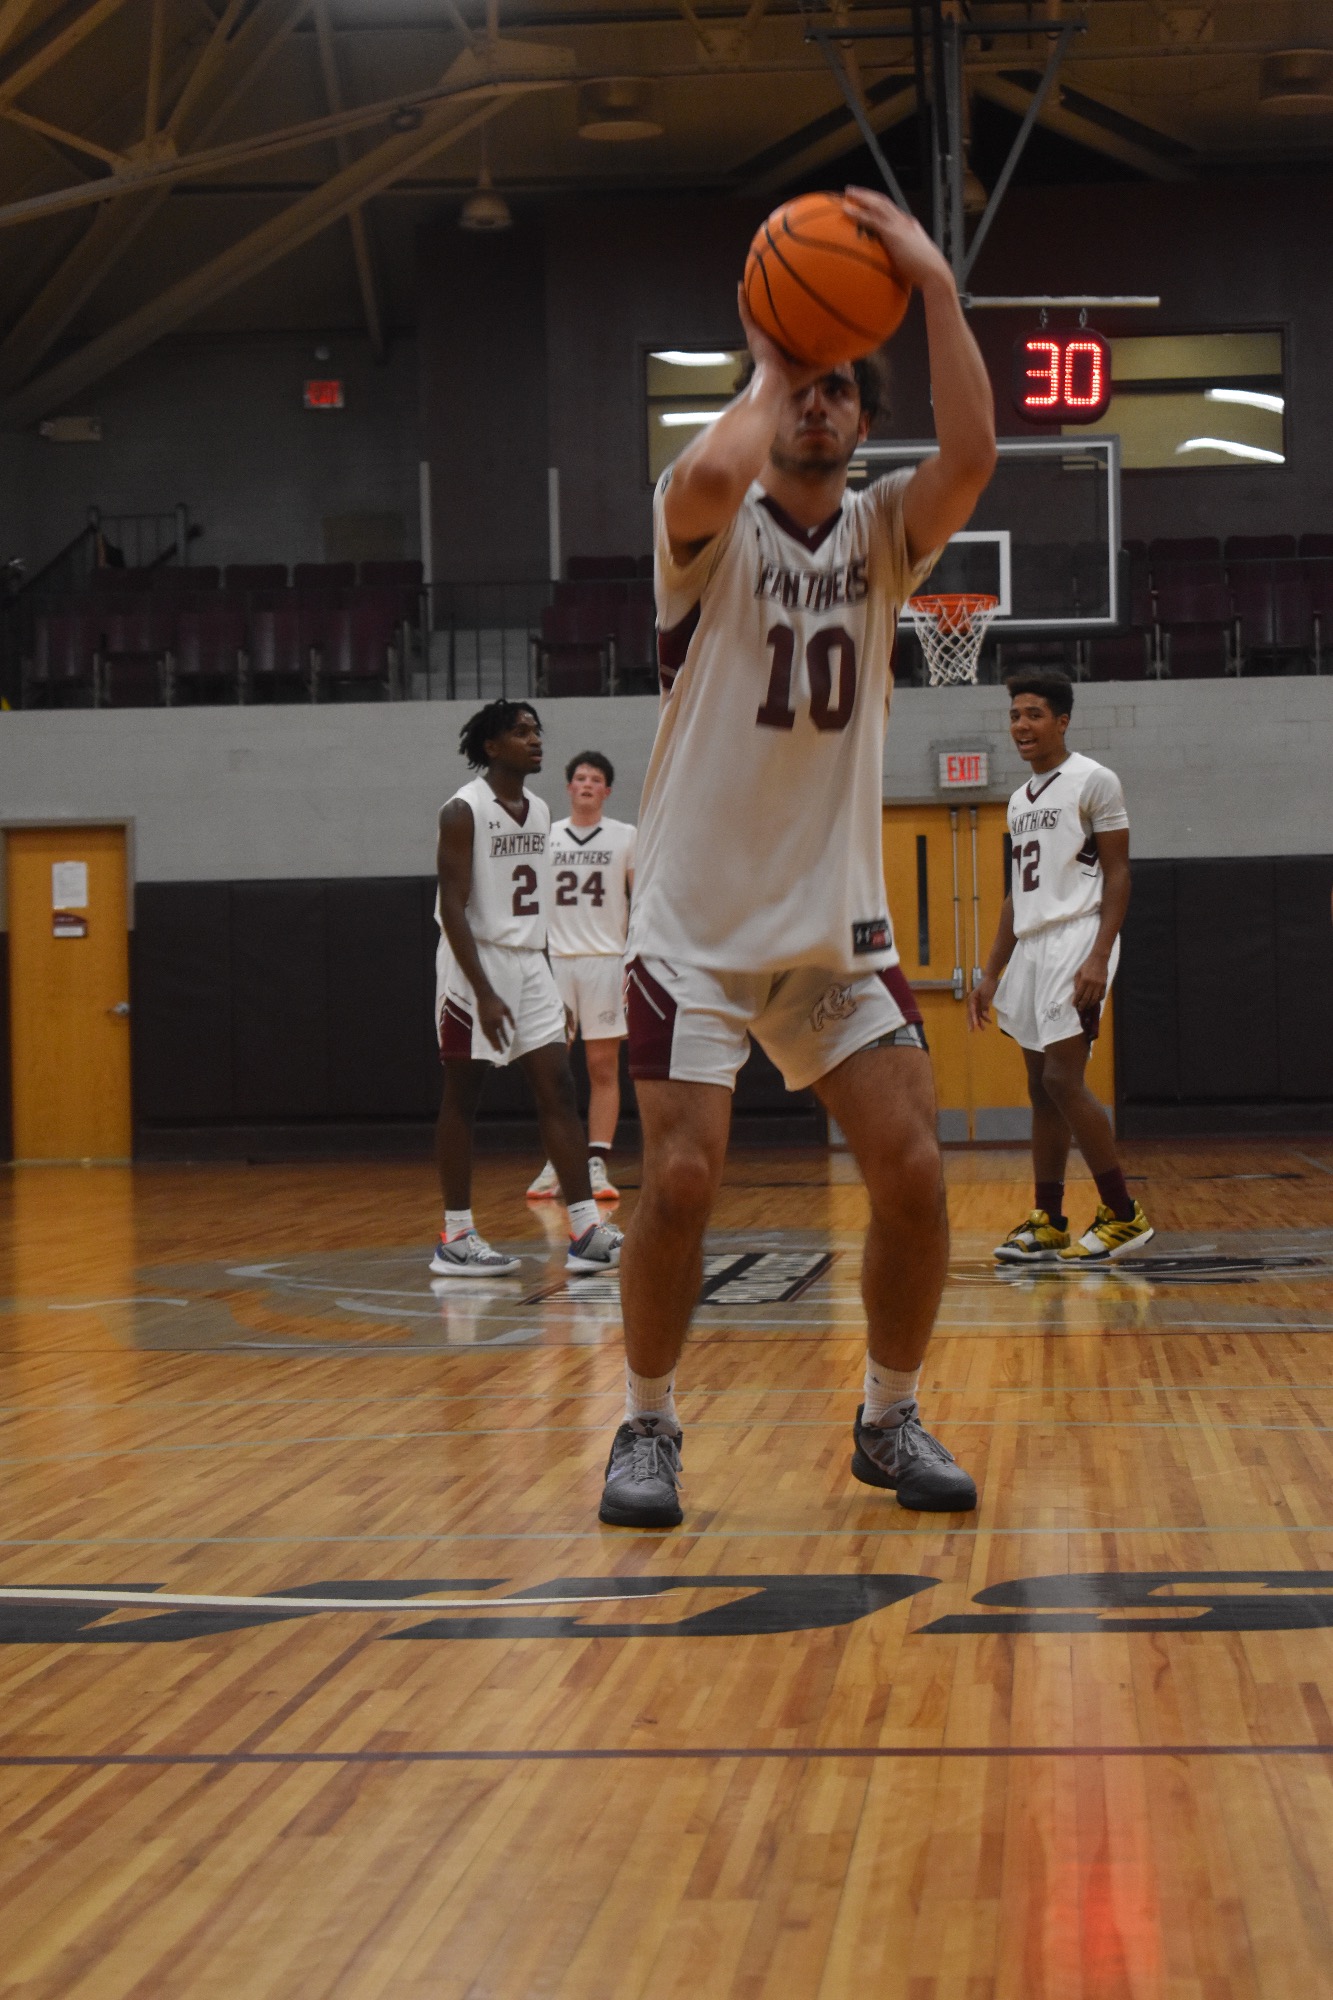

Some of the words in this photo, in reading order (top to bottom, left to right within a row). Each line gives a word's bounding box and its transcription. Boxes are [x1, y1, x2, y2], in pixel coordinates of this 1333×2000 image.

[1026, 342, 1101, 405] 30
[756, 559, 868, 612] PANTHES
[756, 623, 856, 731] 10
[947, 755, 979, 781] EXIT
[554, 852, 610, 865] PANTHERS
[512, 865, 539, 916] 2
[556, 871, 605, 907] 24
